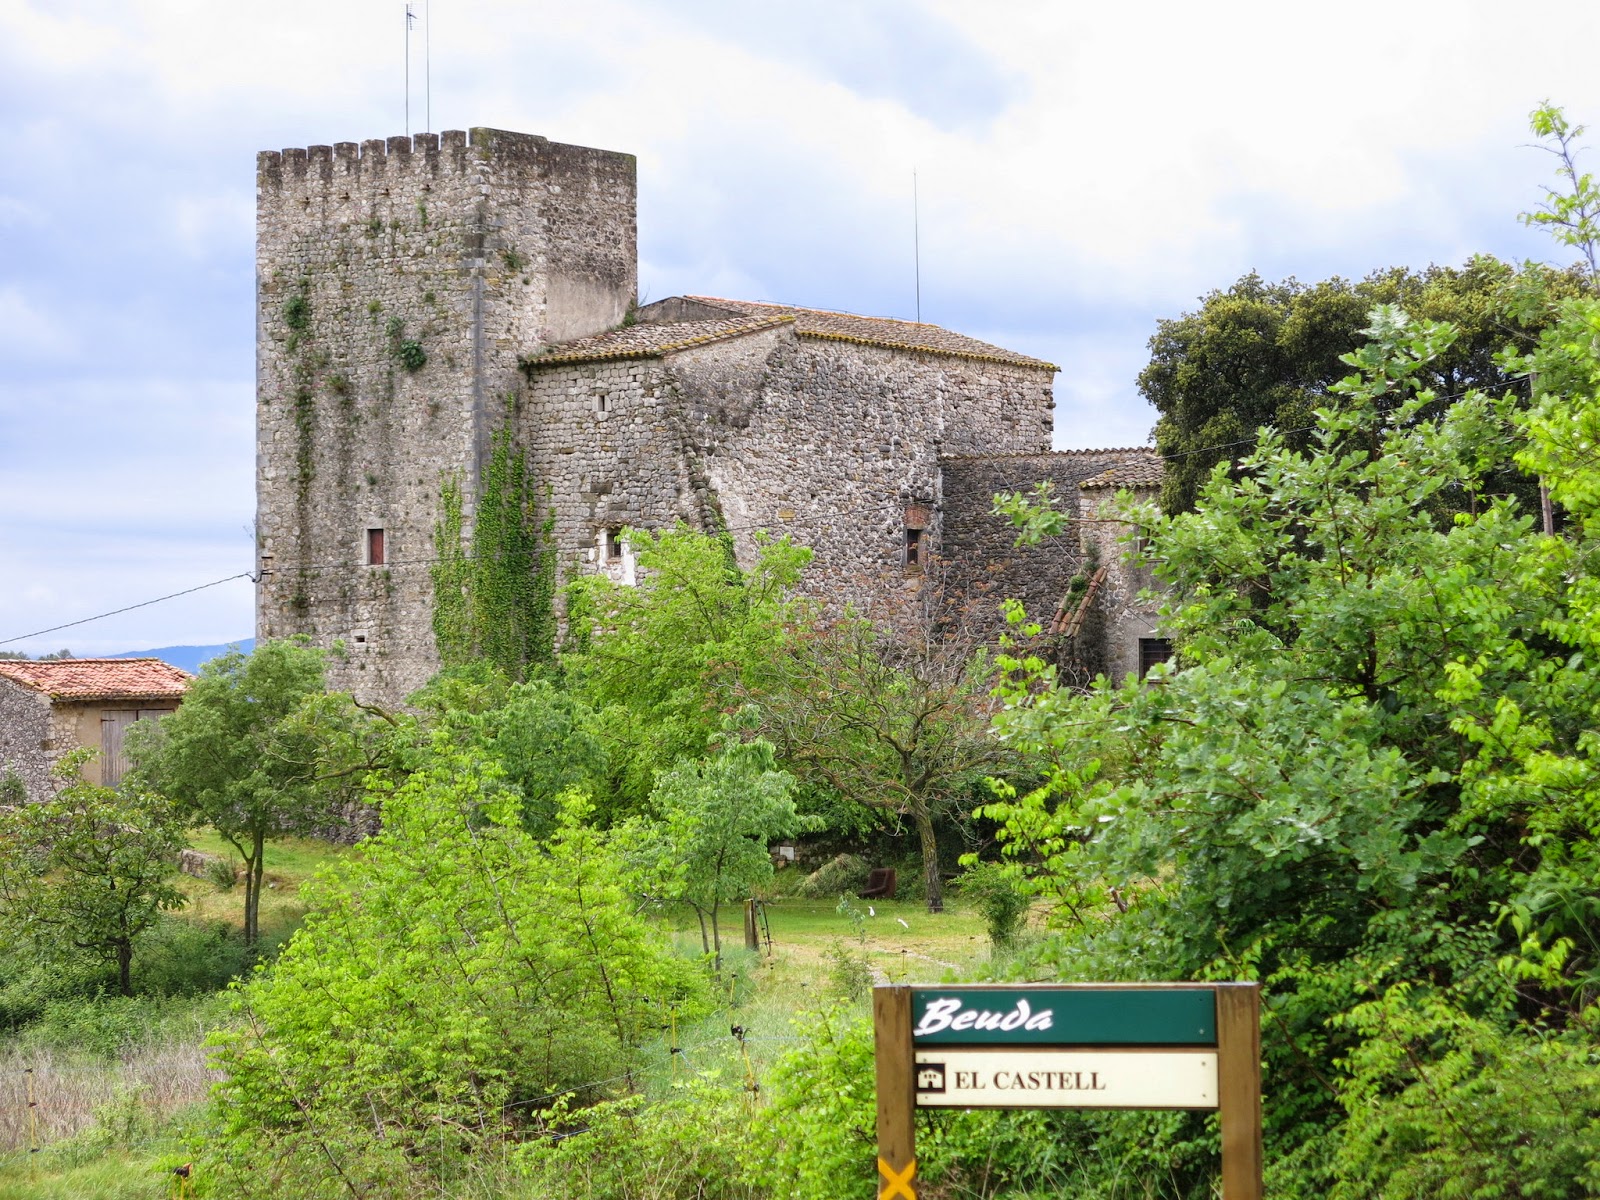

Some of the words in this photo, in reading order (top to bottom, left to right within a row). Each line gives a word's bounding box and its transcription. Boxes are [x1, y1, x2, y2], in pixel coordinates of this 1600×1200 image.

[913, 998, 1053, 1036] Beuda
[955, 1071, 986, 1090] EL
[993, 1071, 1106, 1091] CASTELL
